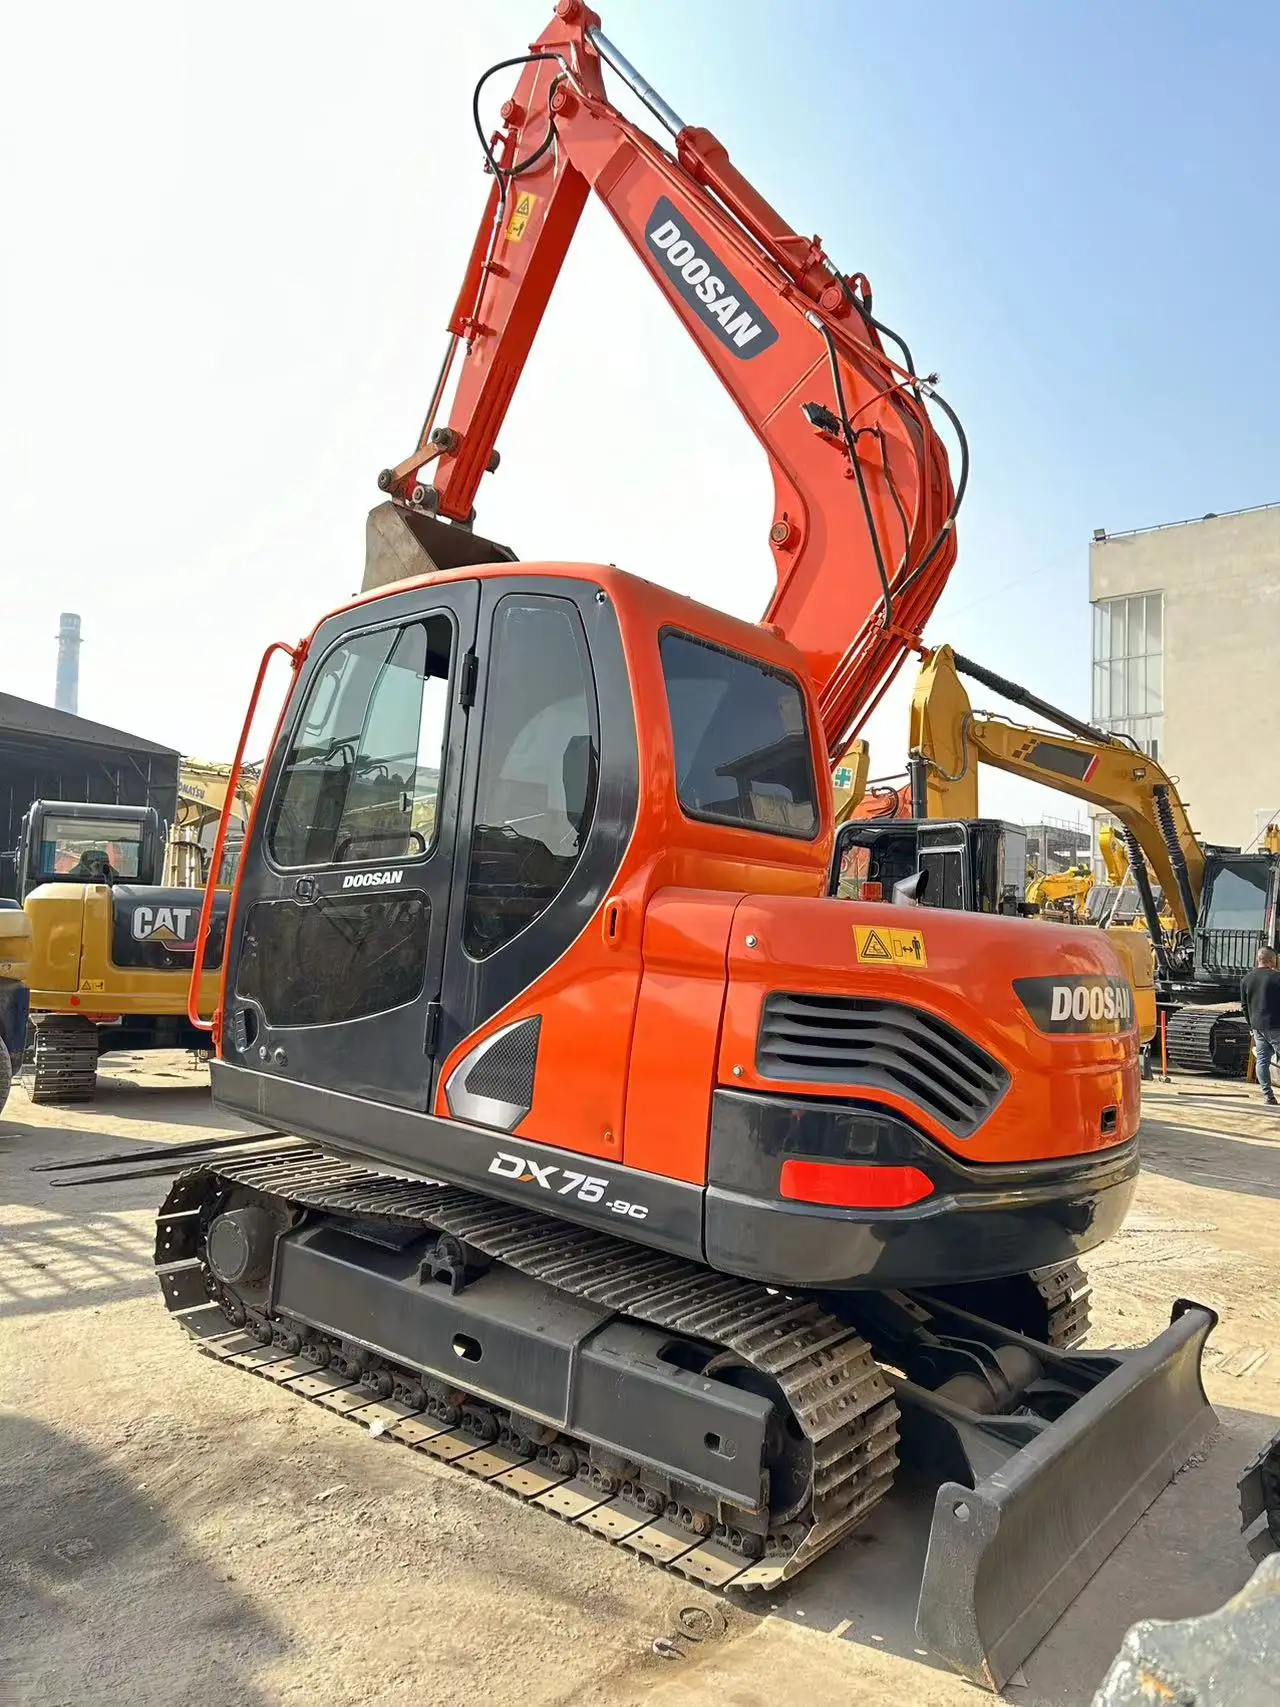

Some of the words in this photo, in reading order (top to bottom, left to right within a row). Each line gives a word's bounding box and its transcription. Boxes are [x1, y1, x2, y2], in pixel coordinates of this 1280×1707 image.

[650, 219, 762, 348] DOOSAN
[342, 870, 404, 889] DOOSAN
[133, 907, 191, 940] CAT
[1050, 986, 1130, 1021] DOOSAN
